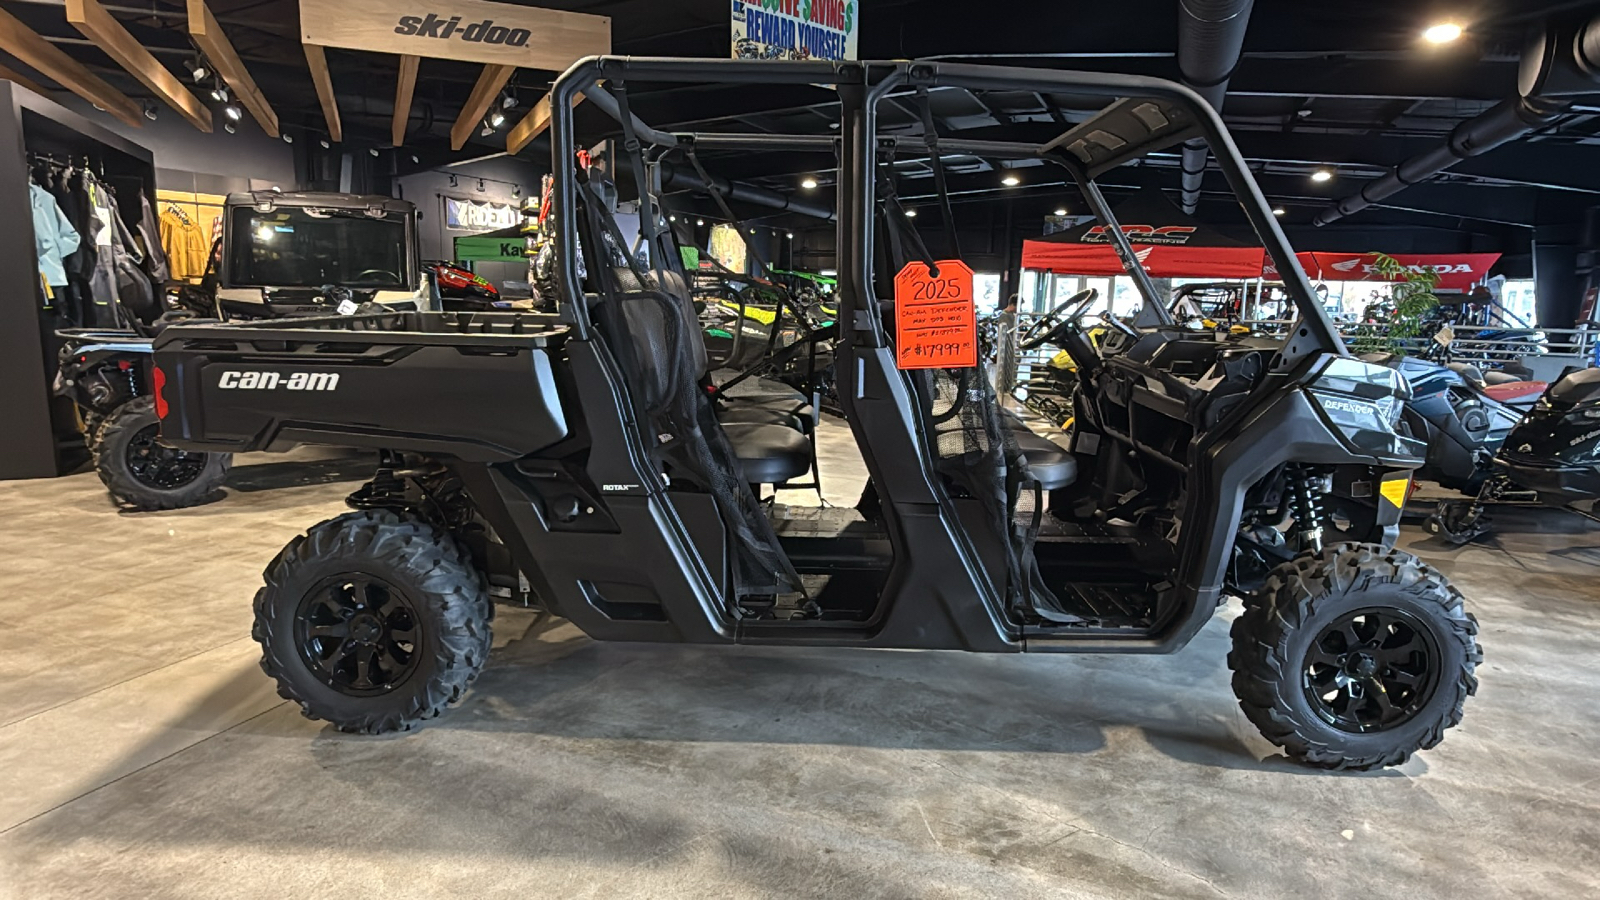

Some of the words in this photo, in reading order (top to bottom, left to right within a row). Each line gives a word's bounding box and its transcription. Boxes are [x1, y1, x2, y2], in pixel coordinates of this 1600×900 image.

[394, 13, 532, 47] ski-doo
[747, 8, 795, 50] REWARD
[798, 22, 847, 60] YOURSELF
[912, 278, 961, 300] 2025
[914, 343, 960, 357] $17999
[218, 371, 340, 390] can-am
[1324, 400, 1374, 416] DEFENDER
